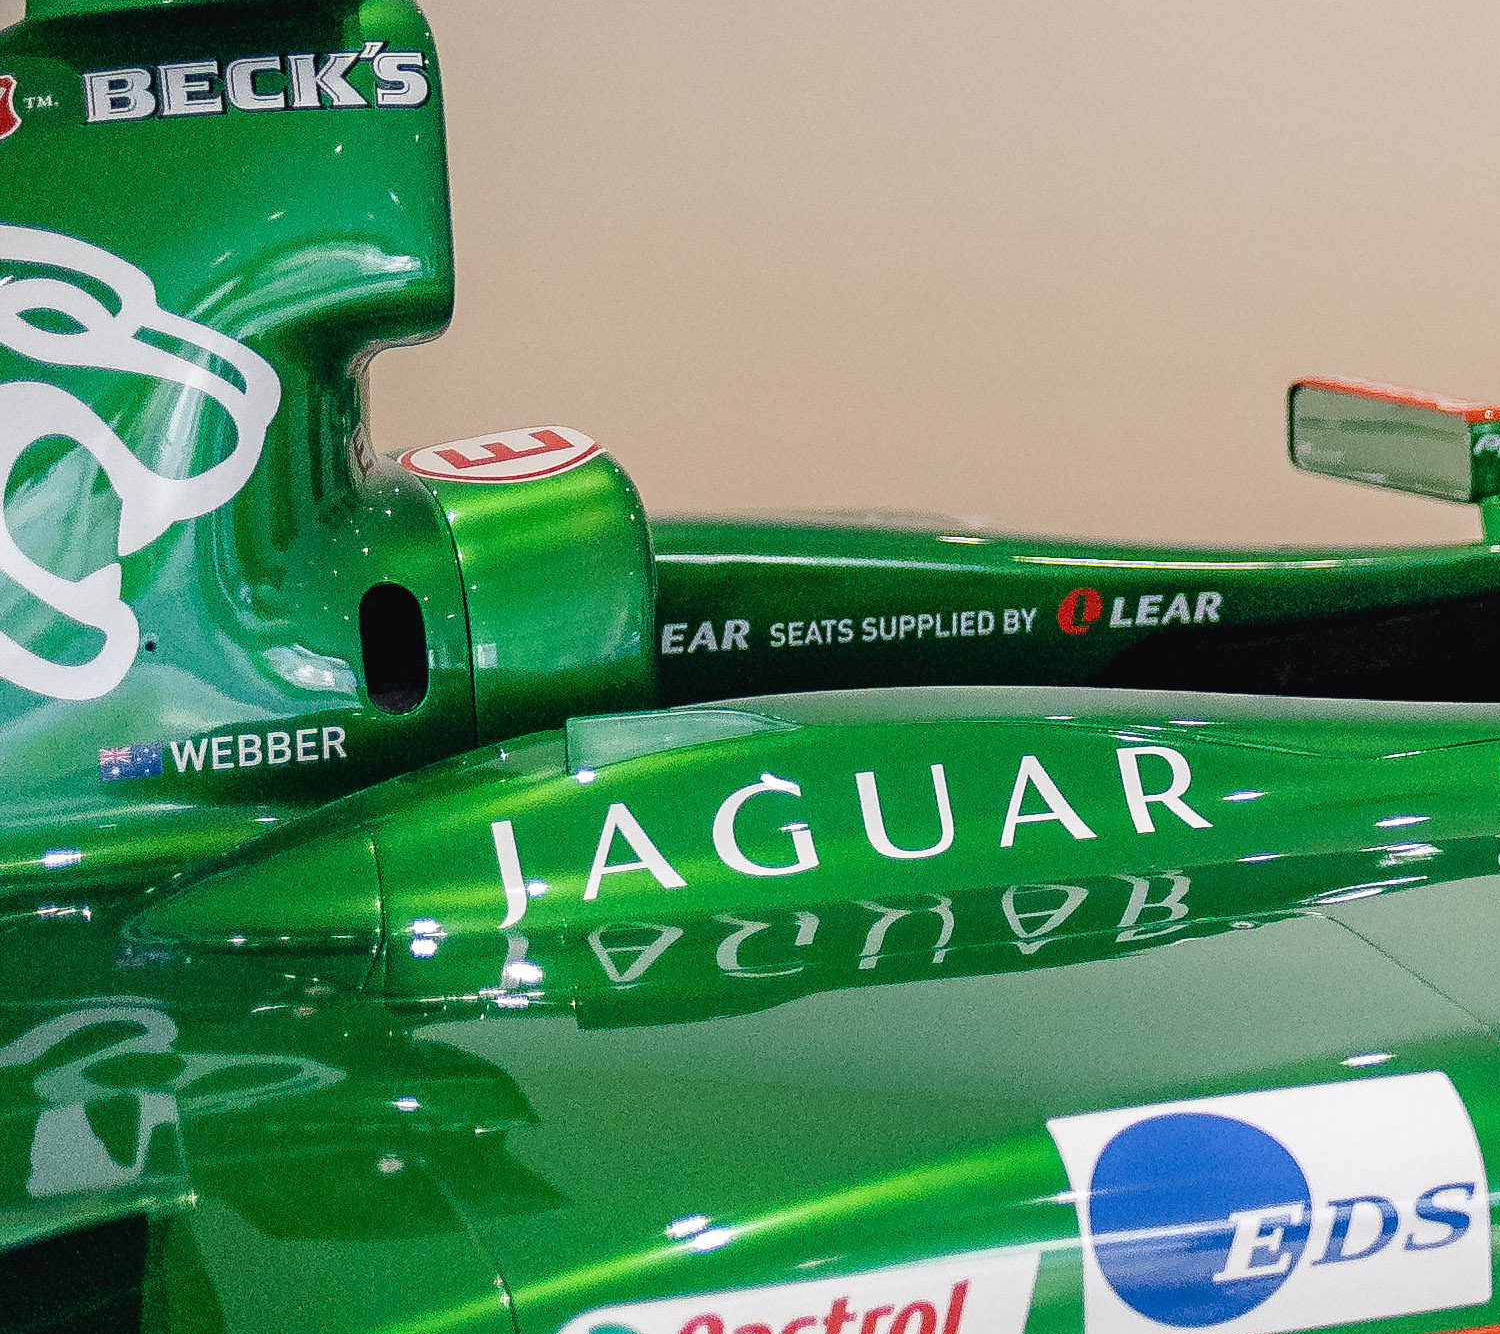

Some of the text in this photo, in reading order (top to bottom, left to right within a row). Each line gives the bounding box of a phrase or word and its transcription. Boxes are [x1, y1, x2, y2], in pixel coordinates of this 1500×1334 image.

[82, 42, 430, 125] BECK'S
[660, 617, 752, 656] EAR
[769, 616, 855, 648] SEATS
[861, 609, 995, 643] SUPPLIED
[1002, 607, 1038, 633] BY
[1109, 591, 1224, 629] LEAR
[170, 725, 348, 773] WEBBER
[491, 744, 1213, 930] JAGUAR
[1213, 1180, 1476, 1285] EDS
